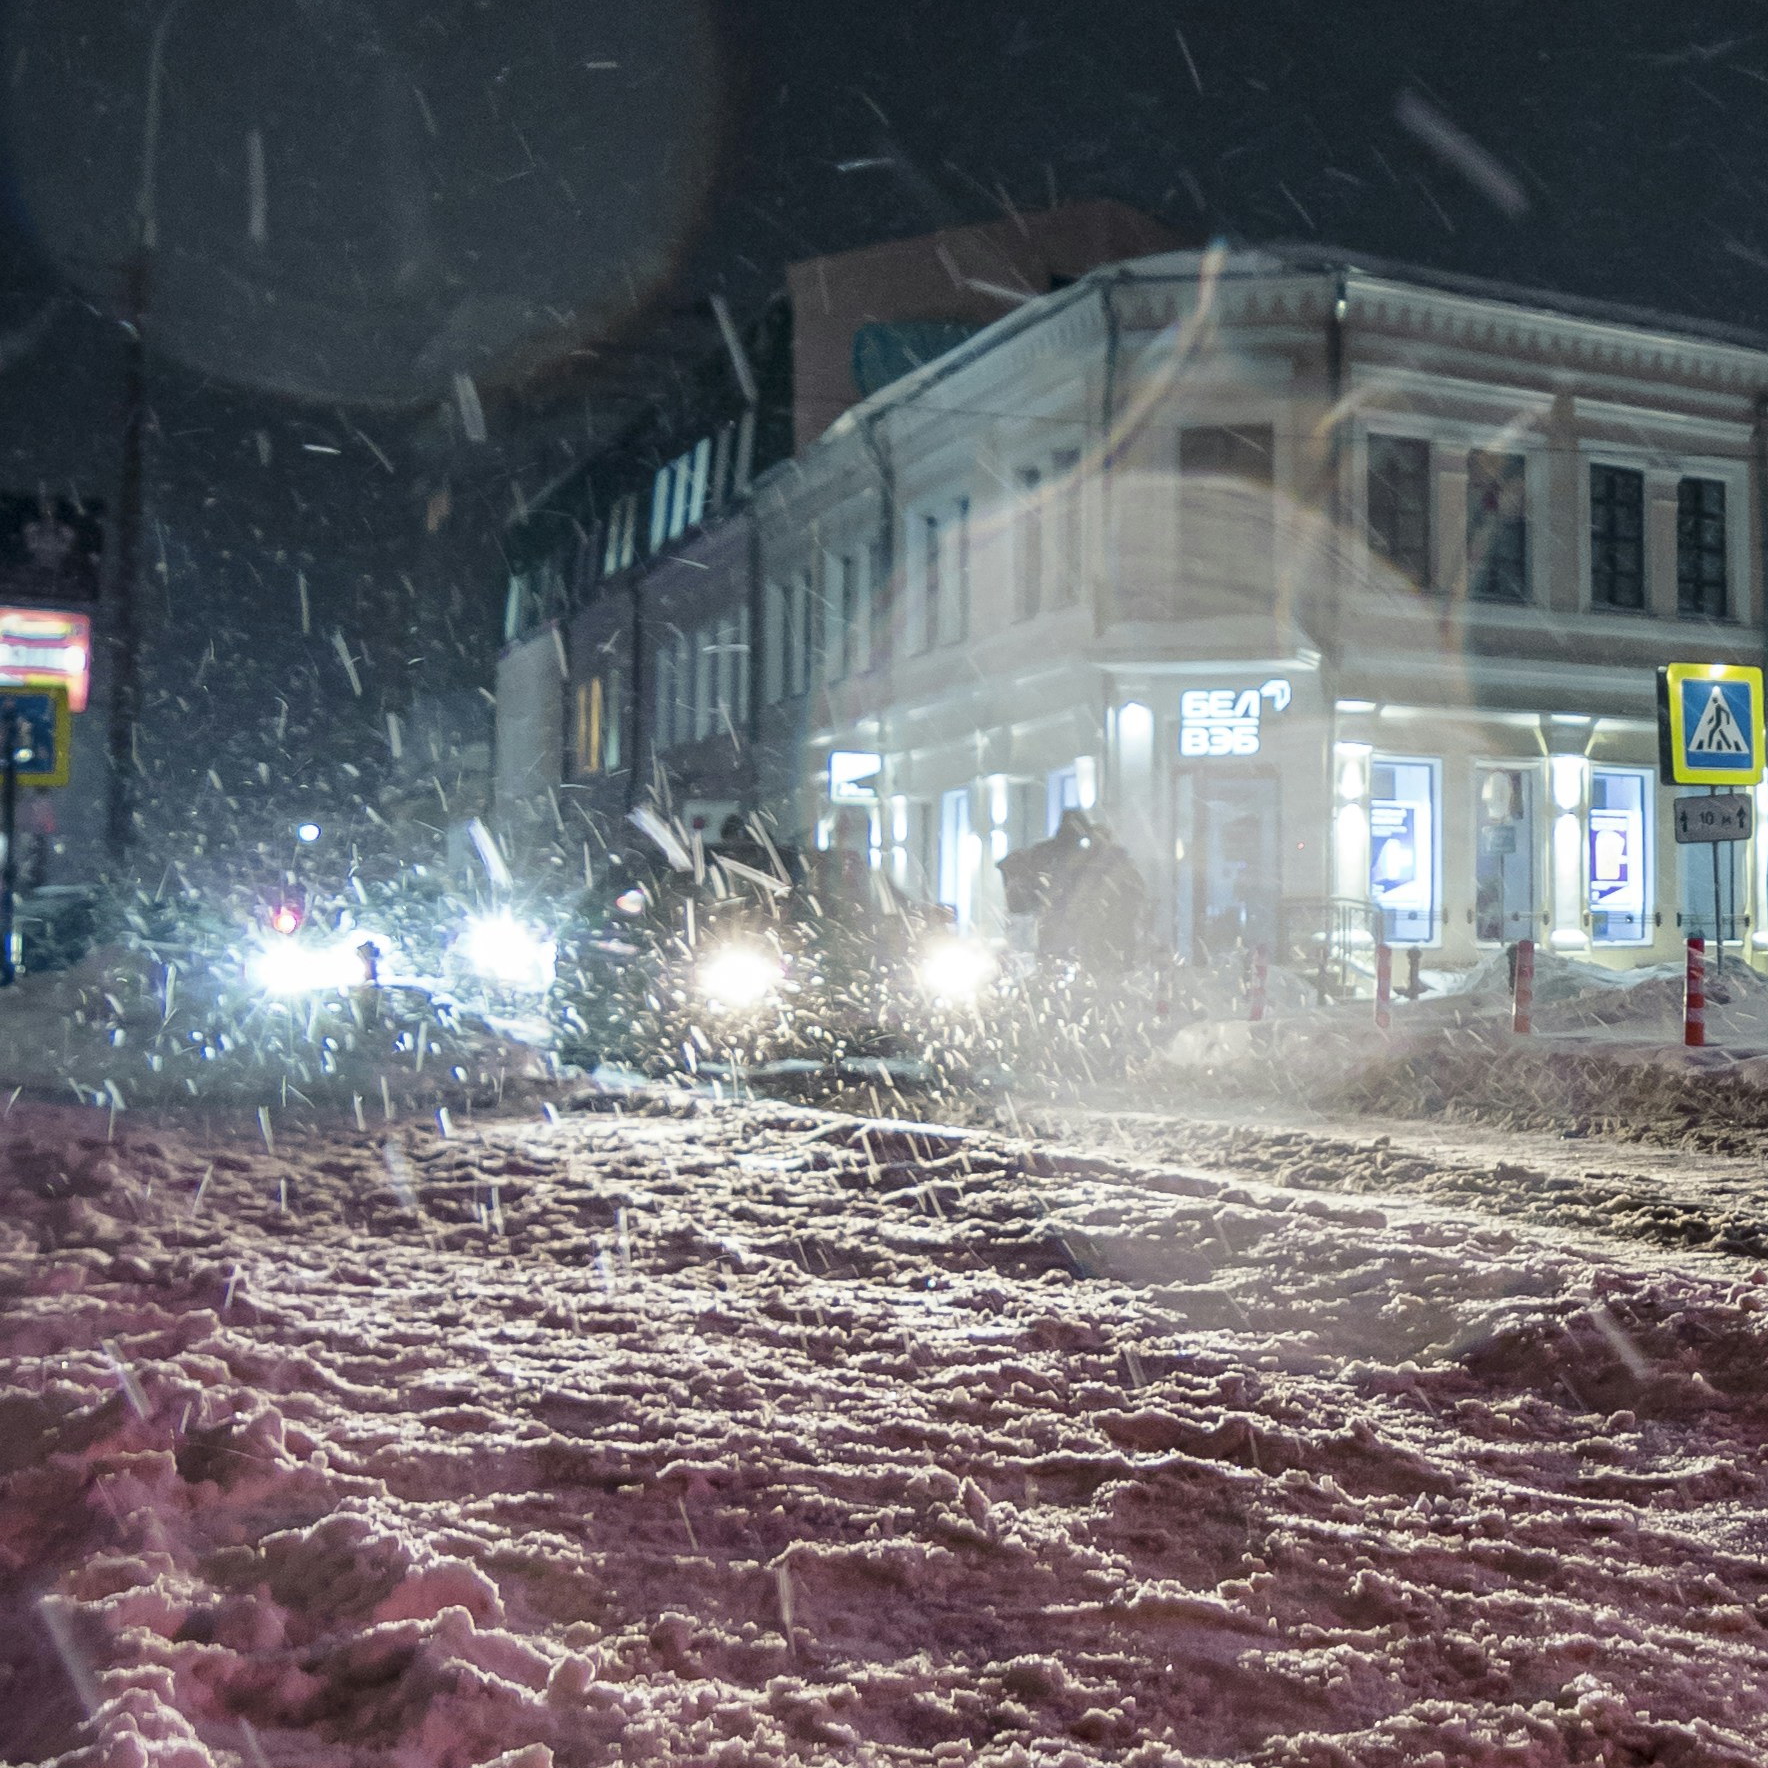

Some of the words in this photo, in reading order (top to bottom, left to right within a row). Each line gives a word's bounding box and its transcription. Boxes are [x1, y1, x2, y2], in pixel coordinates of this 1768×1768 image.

[1181, 689, 1261, 718] БЕЛ
[1180, 726, 1260, 756] ВЭБ
[1700, 811, 1714, 825] 10
